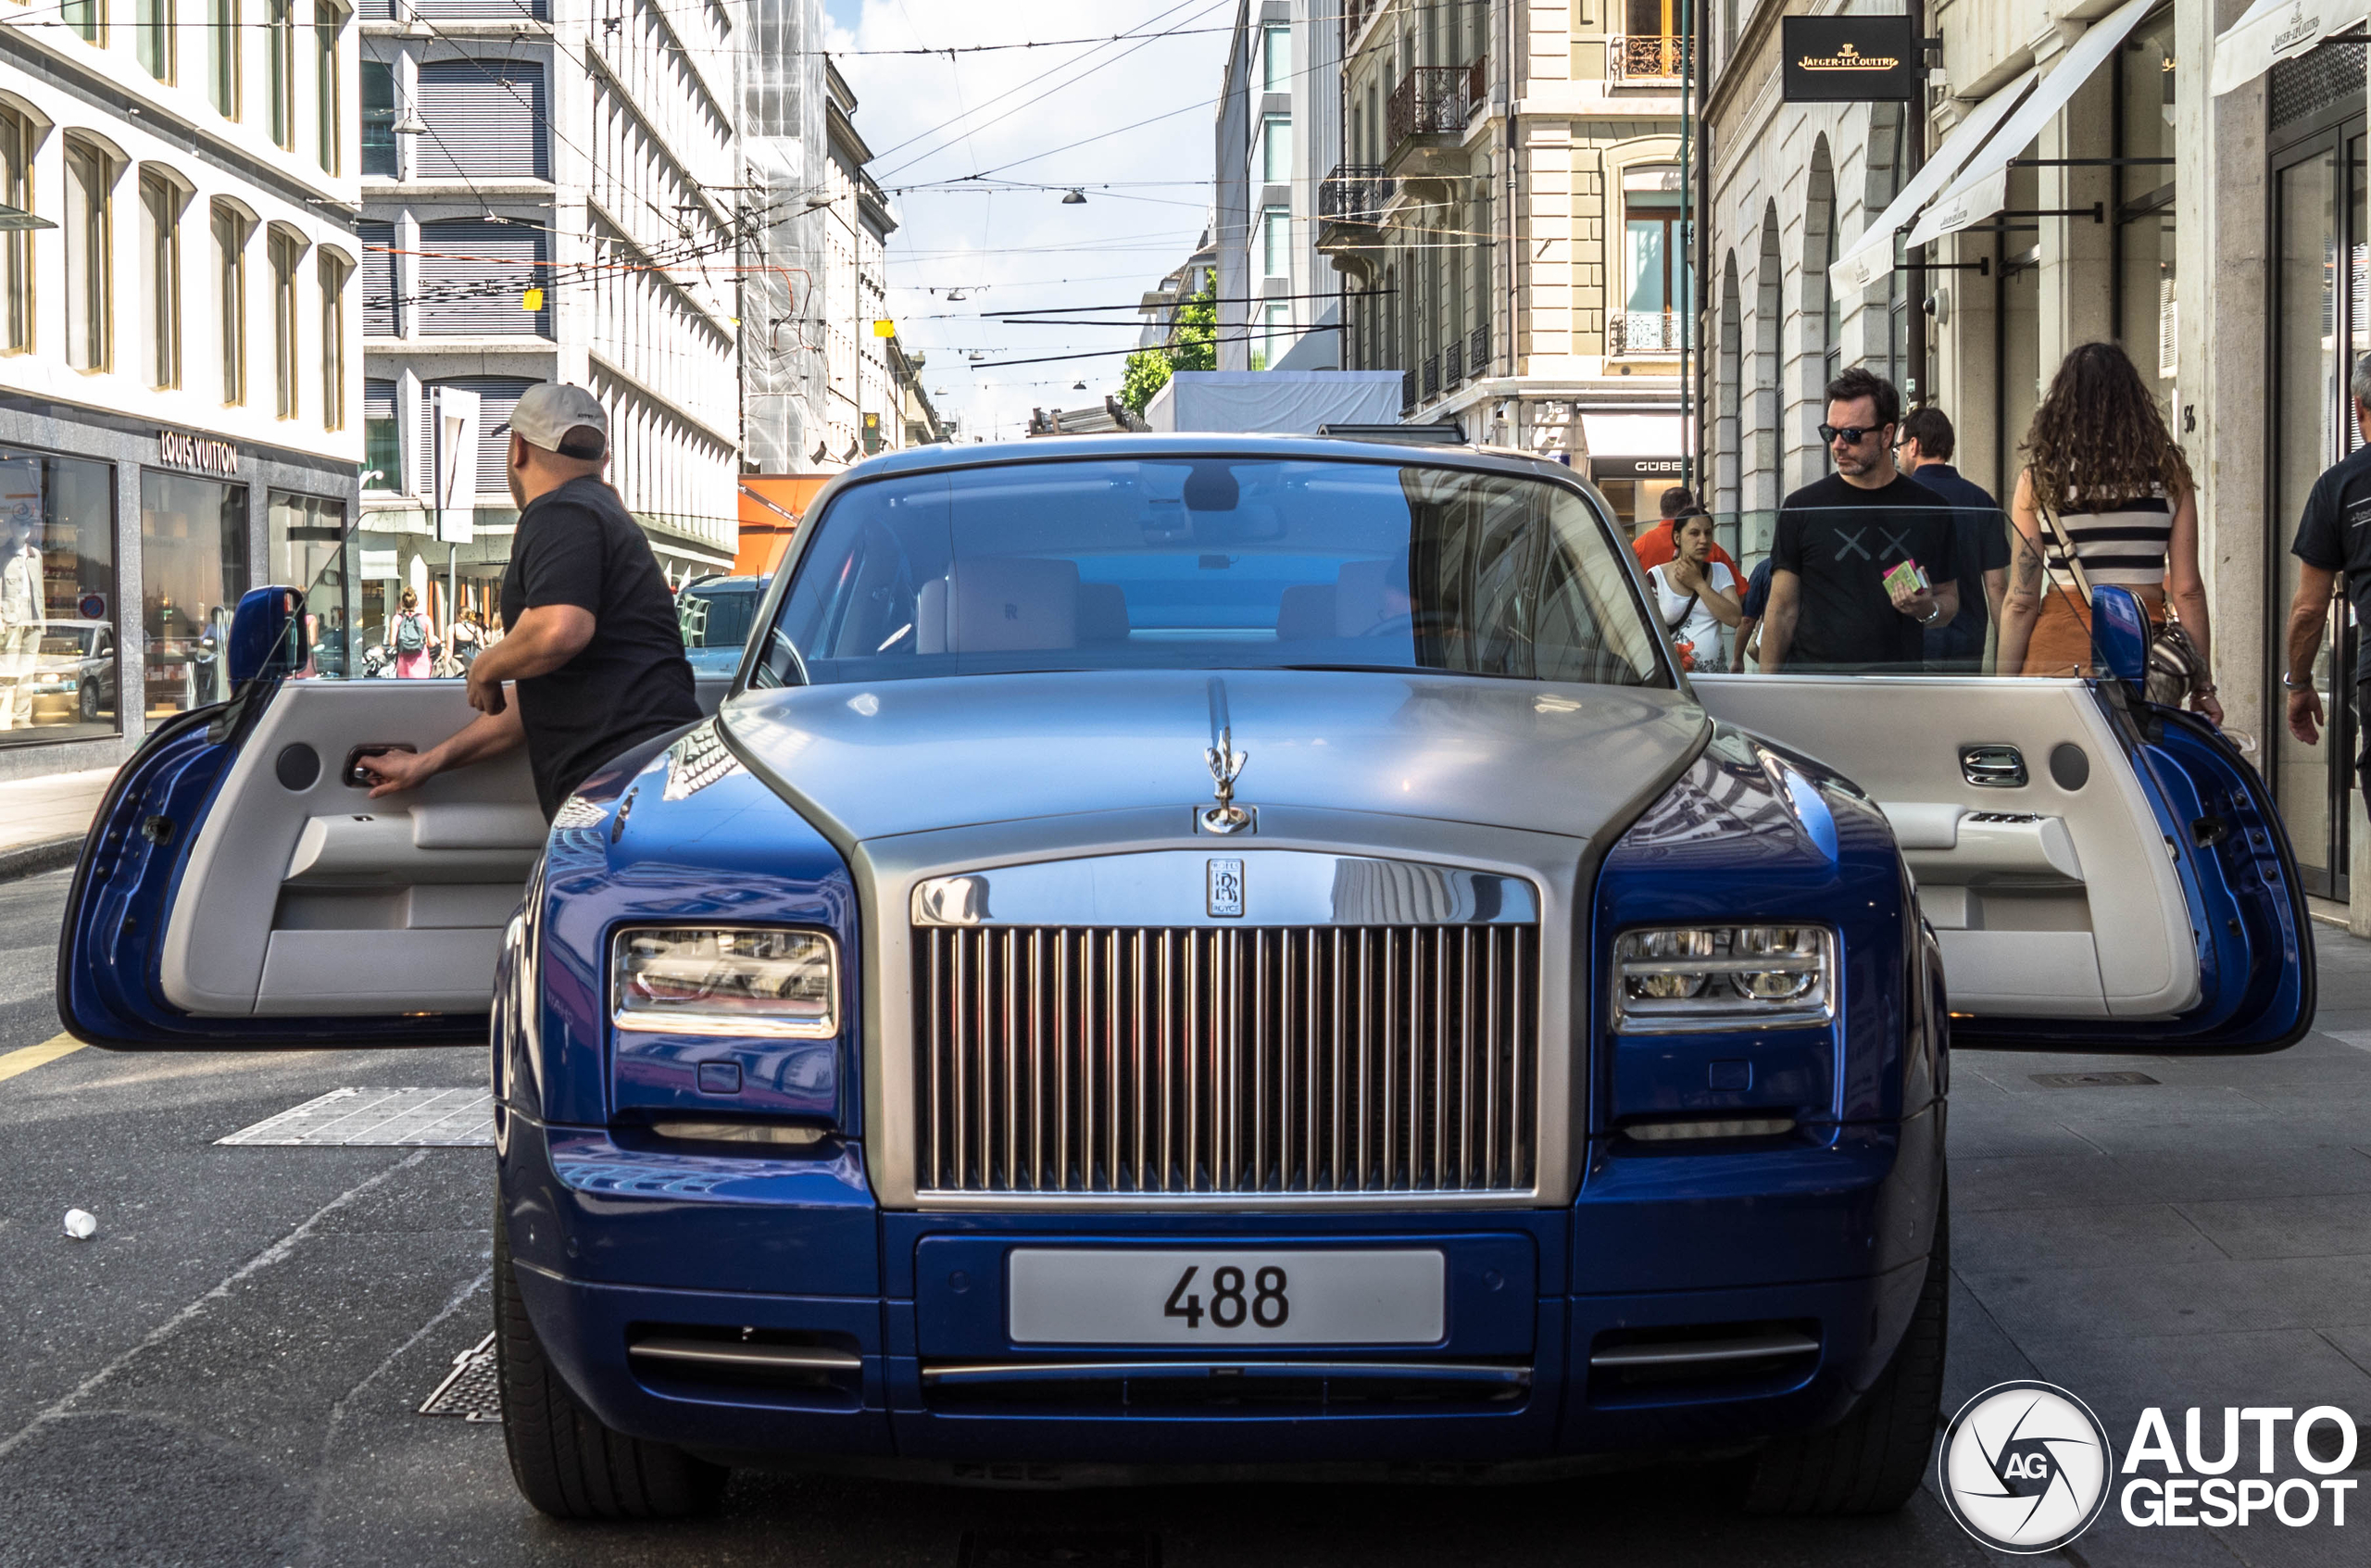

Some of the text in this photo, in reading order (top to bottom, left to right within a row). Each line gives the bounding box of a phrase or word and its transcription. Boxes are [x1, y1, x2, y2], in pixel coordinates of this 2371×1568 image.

[1799, 56, 1896, 67] JAEGER-LECOULTRE
[2184, 404, 2196, 433] 56
[161, 430, 237, 472] LOUIS VUITTON
[1164, 1265, 1289, 1329] 488
